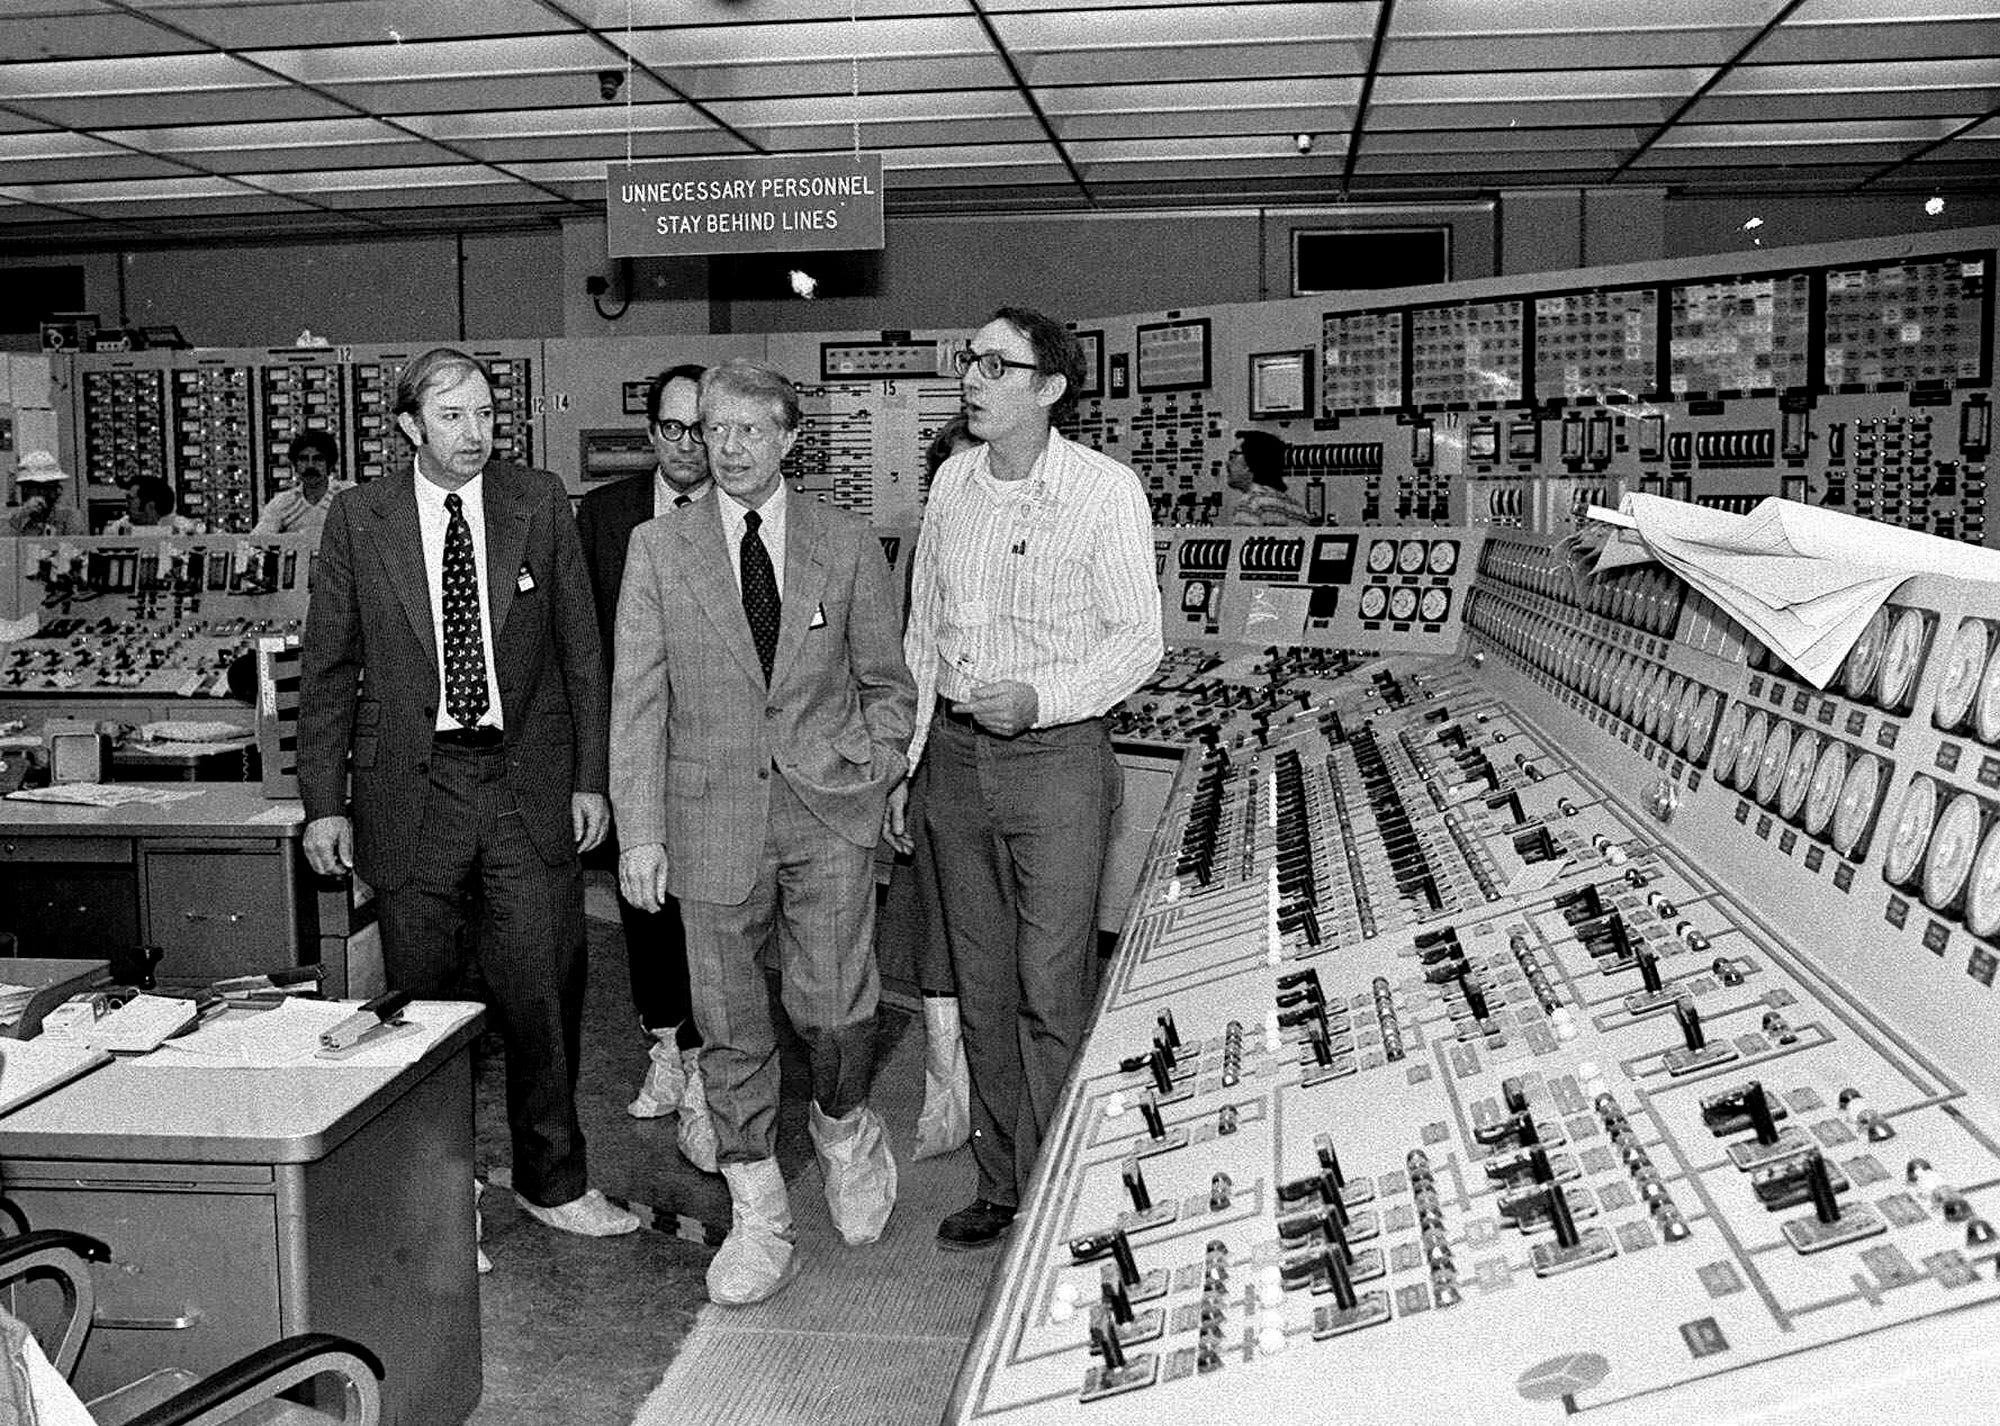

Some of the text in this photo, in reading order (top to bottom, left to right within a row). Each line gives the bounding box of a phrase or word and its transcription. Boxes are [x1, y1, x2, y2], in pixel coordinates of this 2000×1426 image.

[621, 175, 875, 203] UNNECESSARY PERSONNEL
[656, 209, 838, 235] STAY BEHIND LINES
[340, 346, 351, 361] 12
[882, 379, 896, 396] 15
[555, 393, 569, 411] 14
[1447, 411, 1459, 428] 17
